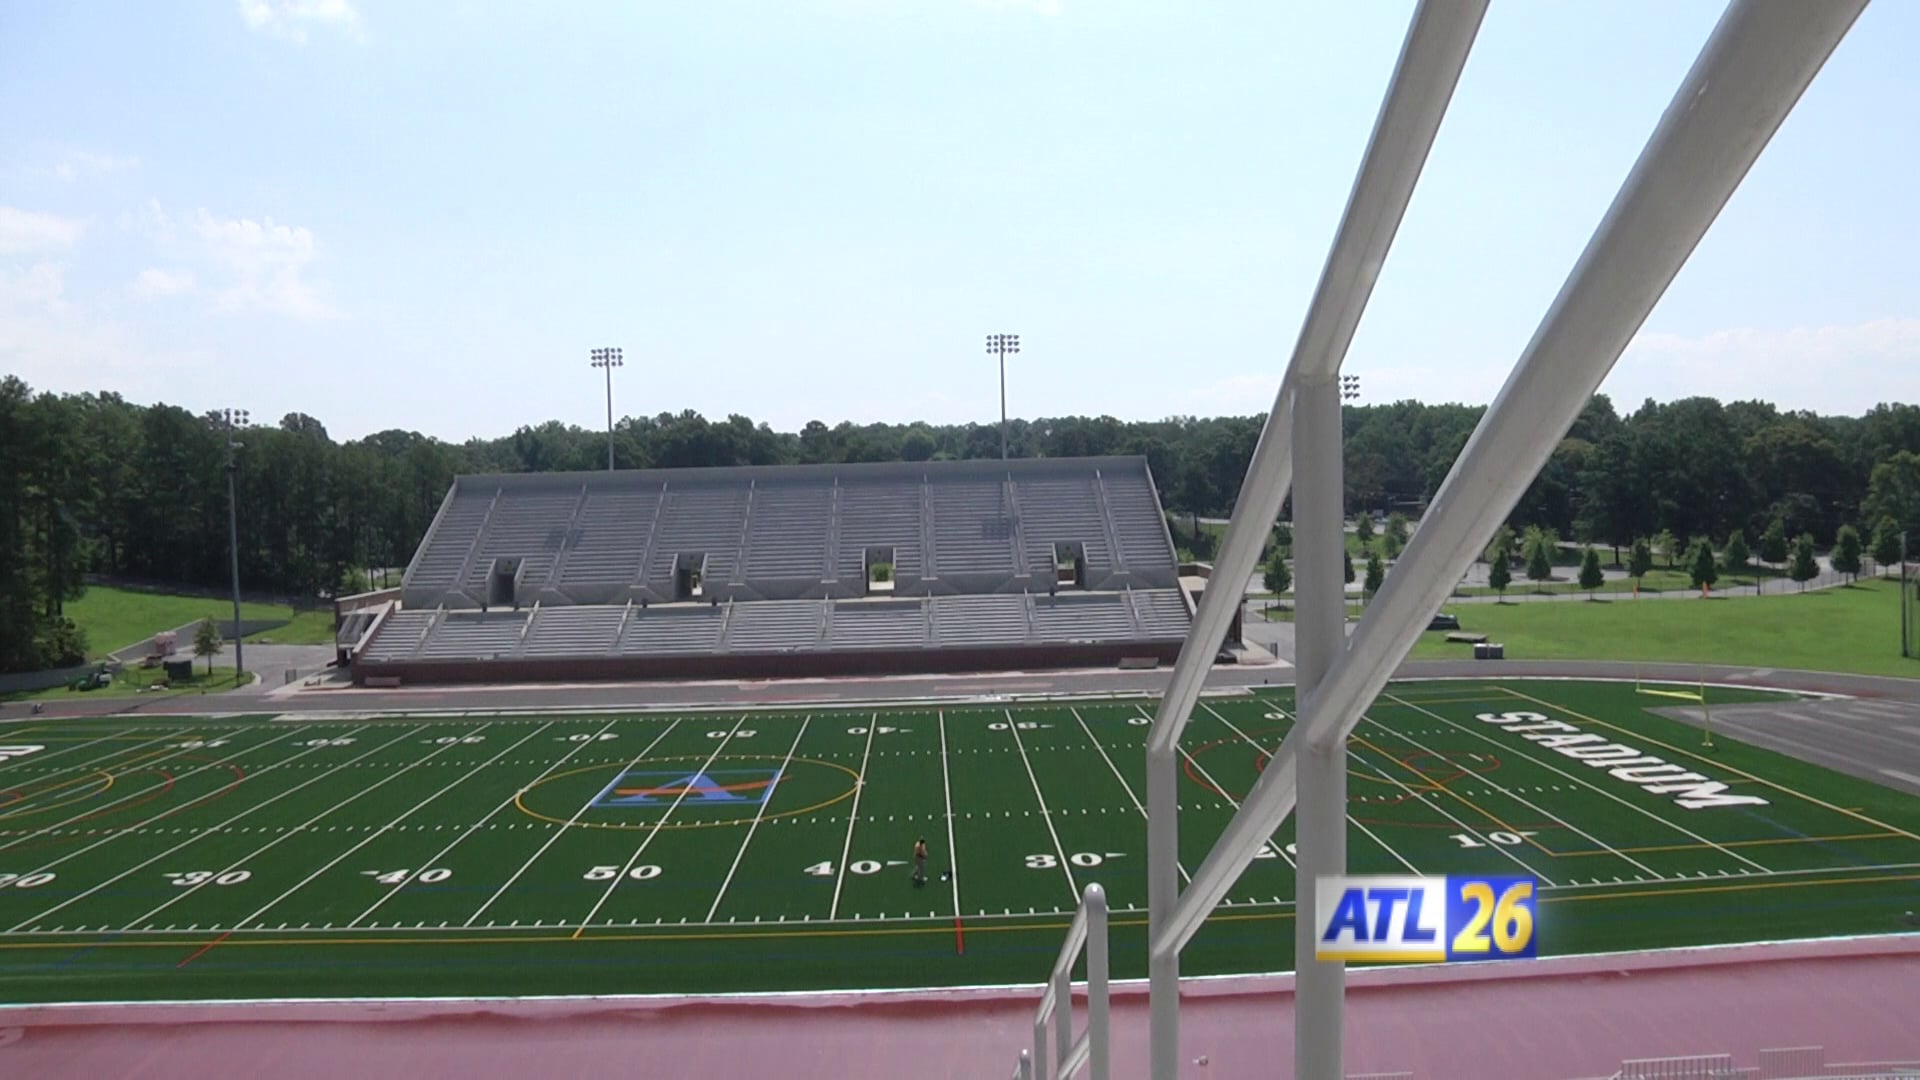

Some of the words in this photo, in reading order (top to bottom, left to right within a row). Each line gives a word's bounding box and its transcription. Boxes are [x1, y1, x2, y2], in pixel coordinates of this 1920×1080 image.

[1475, 711, 1770, 809] STADIUM
[1449, 831, 1523, 849] 10
[803, 860, 882, 876] 40
[1025, 852, 1103, 869] 30
[171, 870, 252, 886] 30
[376, 868, 453, 884] 40
[583, 865, 662, 880] 50
